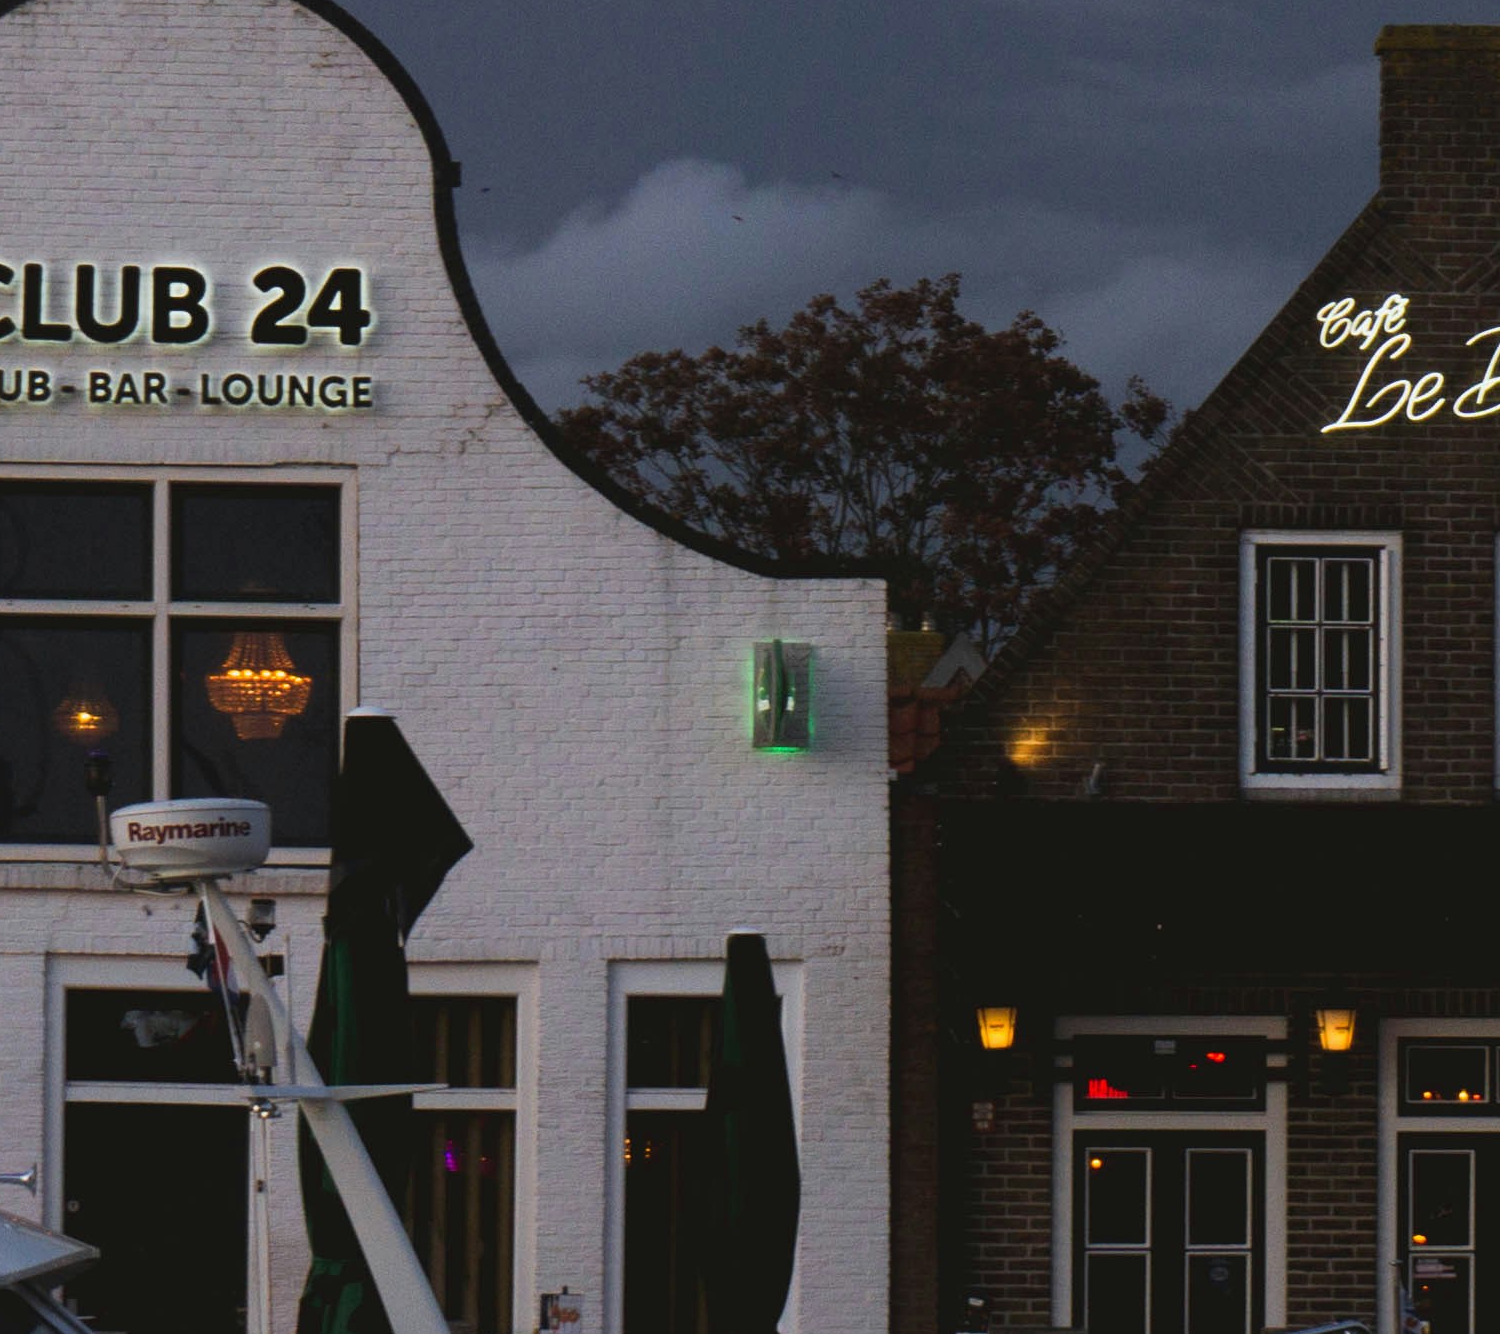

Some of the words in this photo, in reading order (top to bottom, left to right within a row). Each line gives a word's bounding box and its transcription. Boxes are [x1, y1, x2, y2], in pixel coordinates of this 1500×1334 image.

[250, 265, 371, 346] 24
[1316, 293, 1411, 351] Café
[88, 372, 168, 404] BAR
[201, 373, 374, 408] LOUNGE
[1319, 332, 1447, 434] Le
[127, 816, 252, 845] Raymarine
